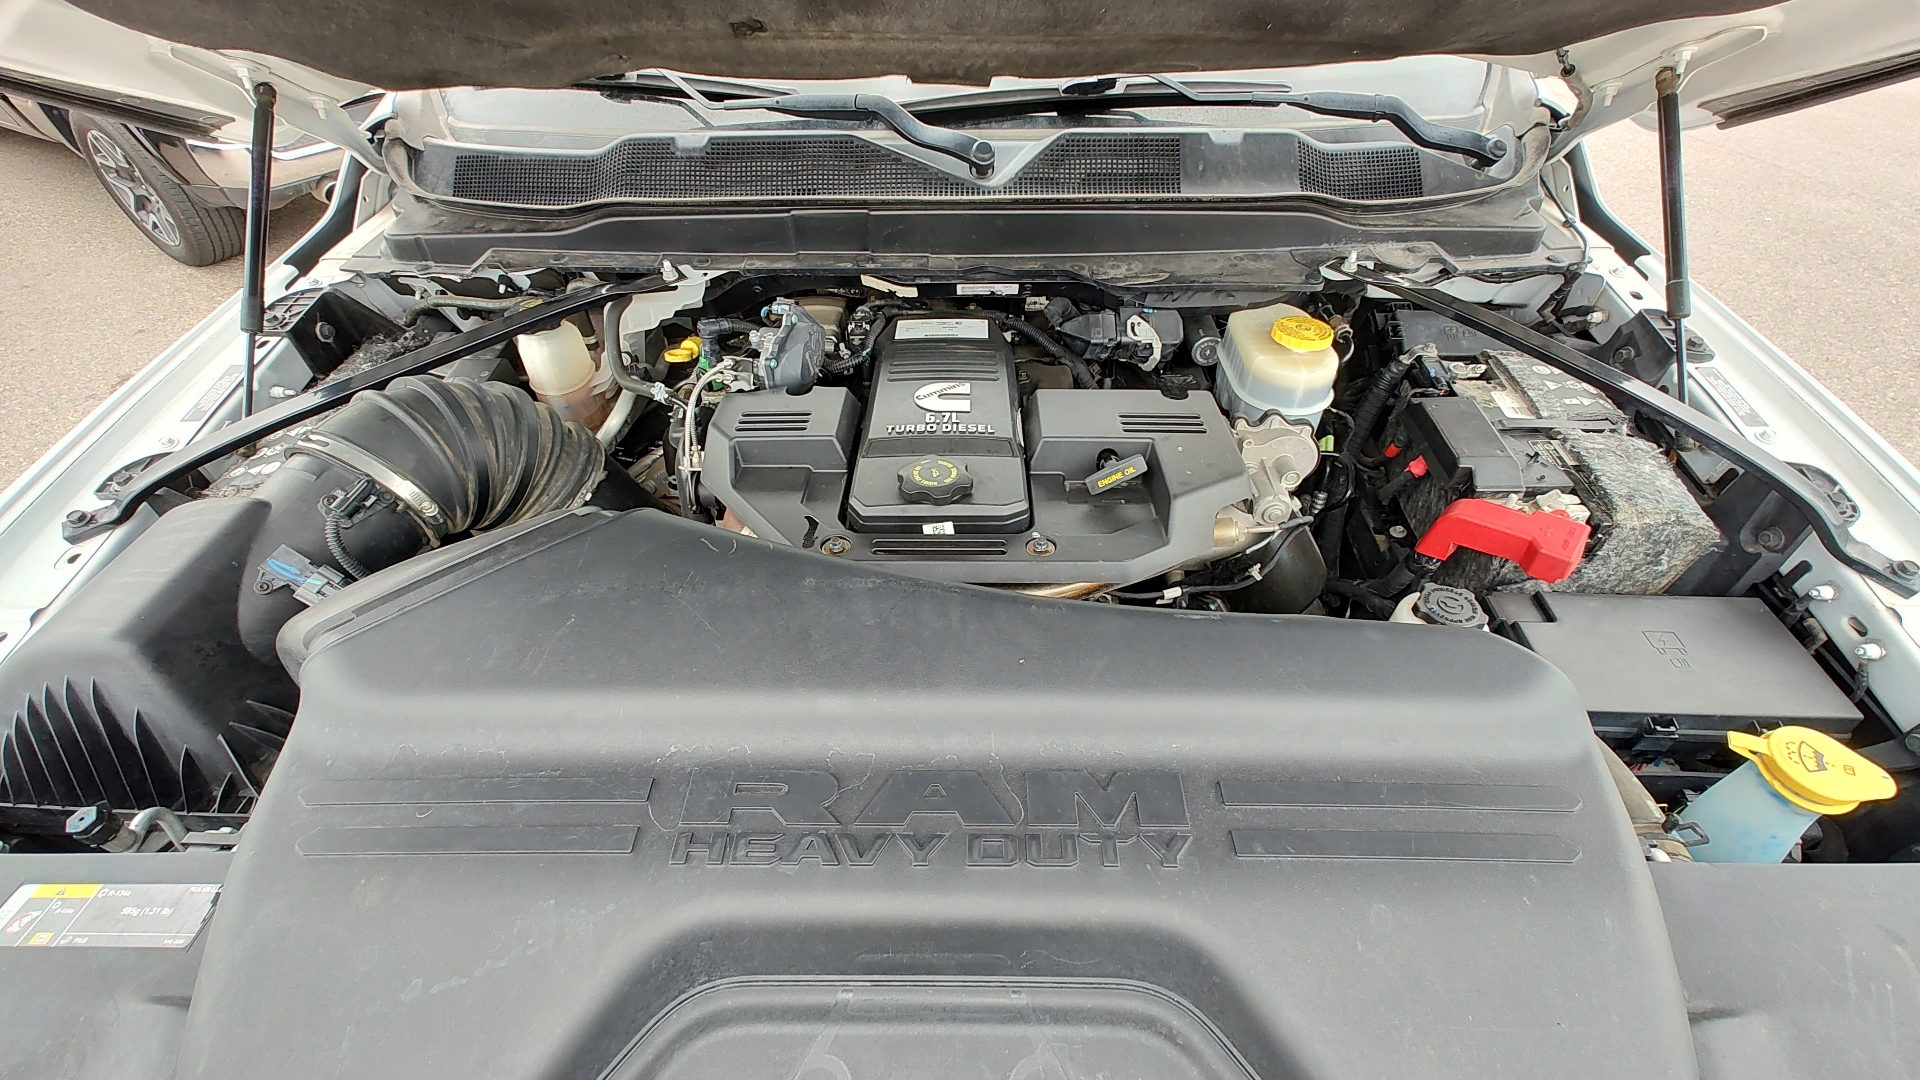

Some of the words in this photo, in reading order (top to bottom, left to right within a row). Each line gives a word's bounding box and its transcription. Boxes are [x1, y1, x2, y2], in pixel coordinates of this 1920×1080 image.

[915, 382, 966, 399] Cummins
[925, 412, 960, 423] 6.7L
[886, 424, 937, 434] TURBO
[941, 424, 995, 434] DIESEL
[1097, 471, 1124, 487] ENGINE
[1124, 466, 1136, 476] OIL
[679, 769, 1191, 828] RAM
[669, 832, 954, 867] HEAVY
[966, 833, 1194, 868] DUTY
